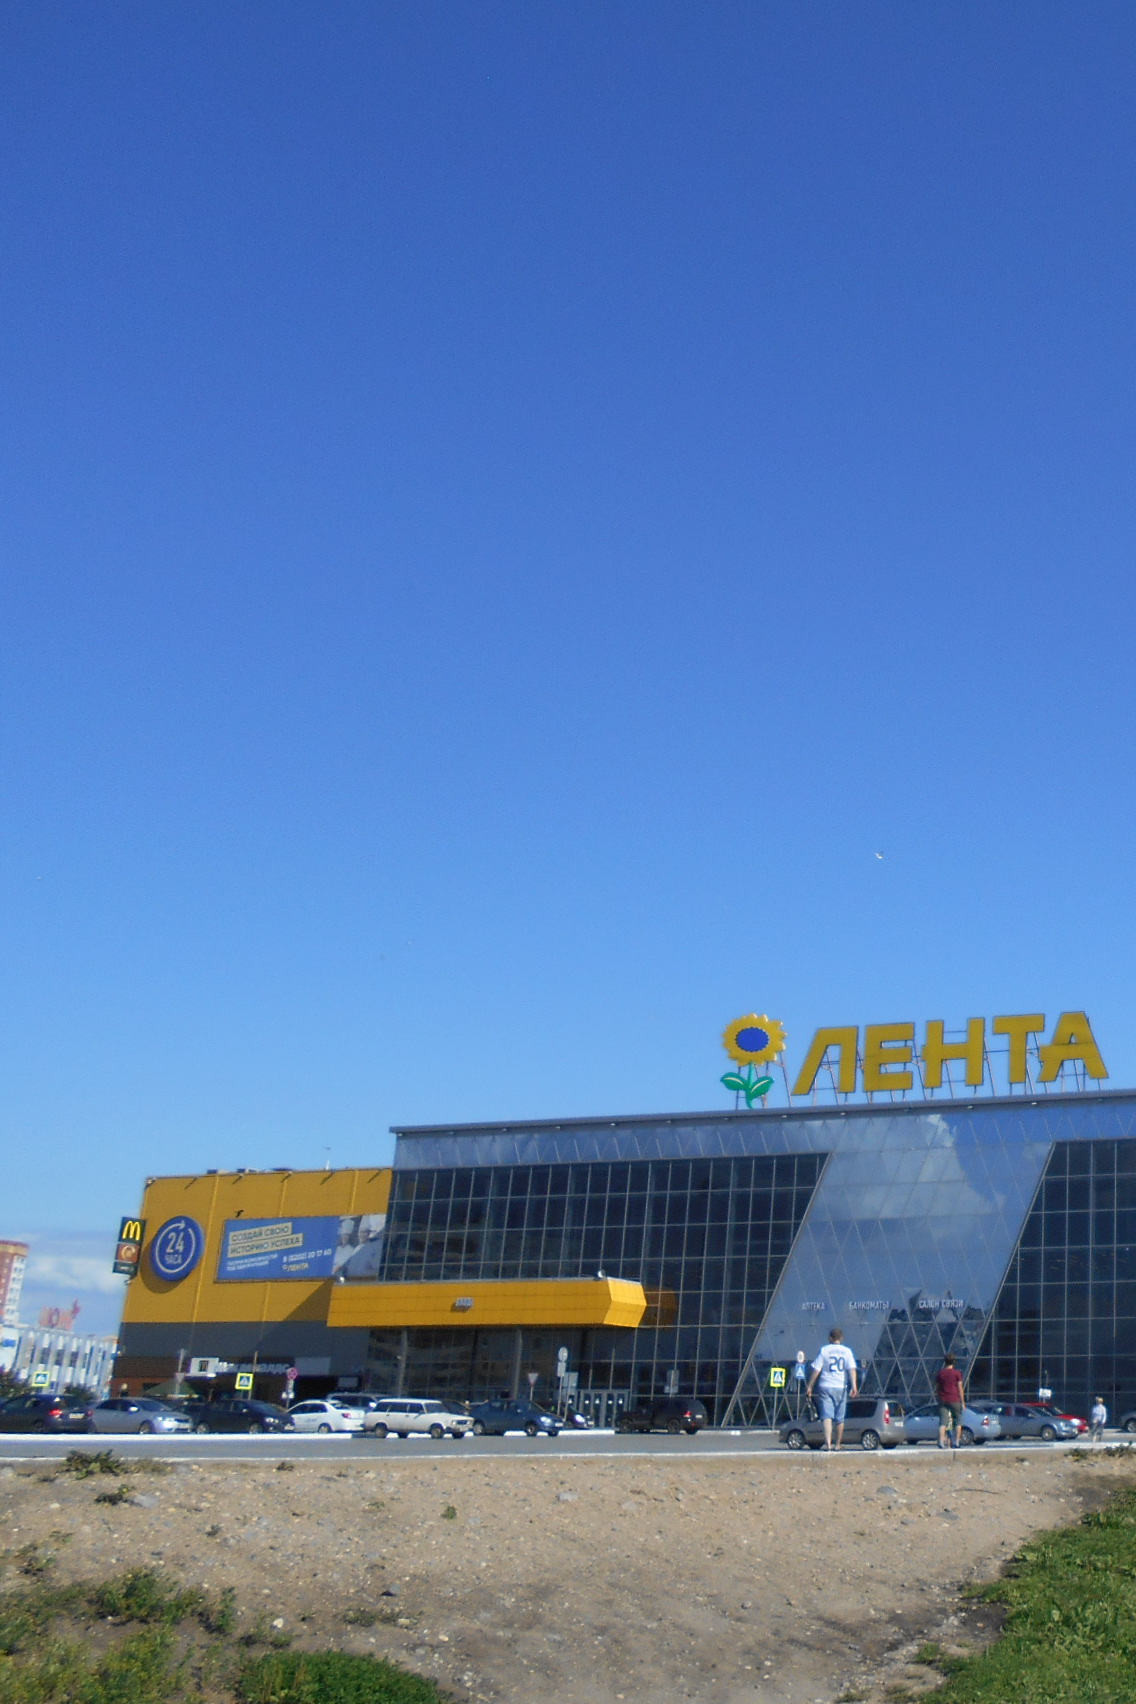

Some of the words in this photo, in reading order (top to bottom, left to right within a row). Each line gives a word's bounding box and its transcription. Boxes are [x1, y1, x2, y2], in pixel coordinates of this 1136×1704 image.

[791, 1011, 1108, 1095] ЛЕНТА
[264, 1225, 289, 1236] СВОЮ
[166, 1232, 184, 1253] 24
[230, 1241, 269, 1254] ИСТОРИЮ
[271, 1236, 301, 1248] УСПЕХА
[801, 1302, 825, 1311] АПТЕКА
[849, 1300, 889, 1310] БАНКОМАТЫ
[918, 1300, 940, 1309] САЛОН
[941, 1299, 964, 1308] СВЯЗИ
[829, 1356, 845, 1372] 20
